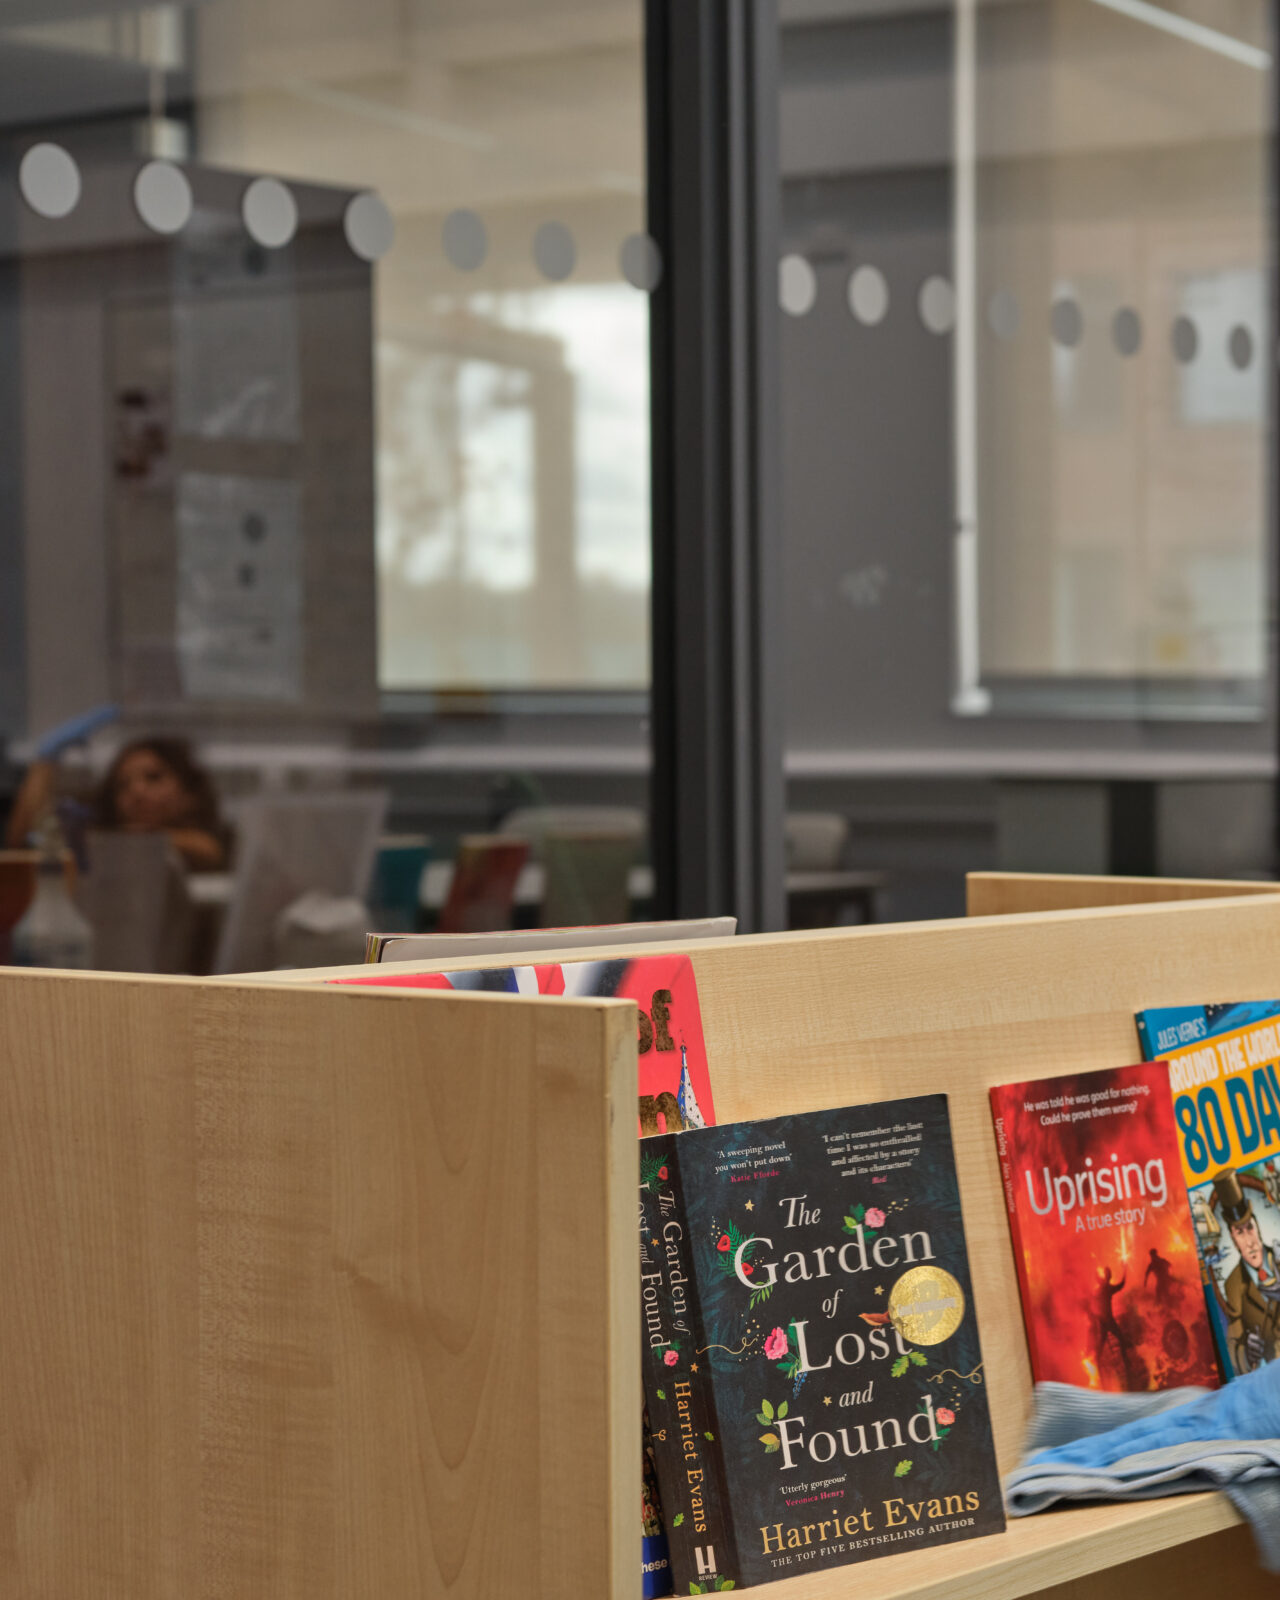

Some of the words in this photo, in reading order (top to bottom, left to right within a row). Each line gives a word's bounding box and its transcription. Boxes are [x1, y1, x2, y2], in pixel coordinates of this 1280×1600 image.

[1157, 1026, 1178, 1051] JULES
[1216, 1037, 1247, 1075] THE
[1024, 1101, 1035, 1113] He
[1035, 1101, 1050, 1111] was
[1049, 1096, 1064, 1109] told
[1064, 1095, 1075, 1105] he
[1075, 1094, 1090, 1104] was
[1090, 1090, 1110, 1104] good
[1109, 1087, 1120, 1099] for
[1040, 1112, 1061, 1126] Could
[1061, 1111, 1071, 1122] he
[1071, 1109, 1092, 1123] prove
[1092, 1106, 1112, 1118] them
[1112, 1100, 1138, 1114] wrong?
[830, 1132, 850, 1142] can't
[851, 1126, 891, 1139] remember
[892, 1124, 906, 1133] the
[995, 1117, 1008, 1156] Uprising
[1174, 1086, 1232, 1175] 80
[727, 1145, 763, 1157] sweeping
[764, 1140, 786, 1152] novel
[827, 1146, 846, 1155] time
[846, 1143, 851, 1152] I
[831, 1156, 847, 1166] and
[847, 1151, 879, 1164] affected
[880, 1151, 890, 1161] by
[898, 1148, 921, 1156] story
[714, 1165, 729, 1175] you
[730, 1160, 752, 1170] won't
[754, 1157, 767, 1168] put
[730, 1174, 751, 1183] Katie
[753, 1169, 780, 1179] Fforde
[841, 1167, 857, 1177] and
[1025, 1152, 1168, 1226] Uprising
[658, 1190, 676, 1217] The
[778, 1194, 822, 1229] The
[1075, 1216, 1086, 1233] A
[1087, 1212, 1113, 1232] true
[1114, 1206, 1147, 1226] story
[639, 1243, 655, 1264] and
[734, 1223, 936, 1289] Garden
[662, 1221, 689, 1315] Garden
[641, 1270, 672, 1349] Found
[821, 1288, 844, 1319] of
[672, 1319, 692, 1336] of
[789, 1320, 913, 1374] Lost
[838, 1380, 875, 1408] and
[773, 1394, 942, 1471] Found
[673, 1381, 699, 1462] Harriet
[686, 1468, 708, 1534] Evans
[785, 1495, 818, 1507] Veronica
[820, 1489, 845, 1500] Henry
[759, 1508, 875, 1555] Harriet
[882, 1490, 980, 1528] Evans
[771, 1555, 793, 1568] THE
[796, 1549, 817, 1562] TOP
[820, 1543, 846, 1556] FIVE
[849, 1527, 925, 1550] BESTSELLING
[928, 1517, 976, 1534] AUTHOR
[694, 1545, 717, 1575] H
[698, 1573, 718, 1581] REVIEW
